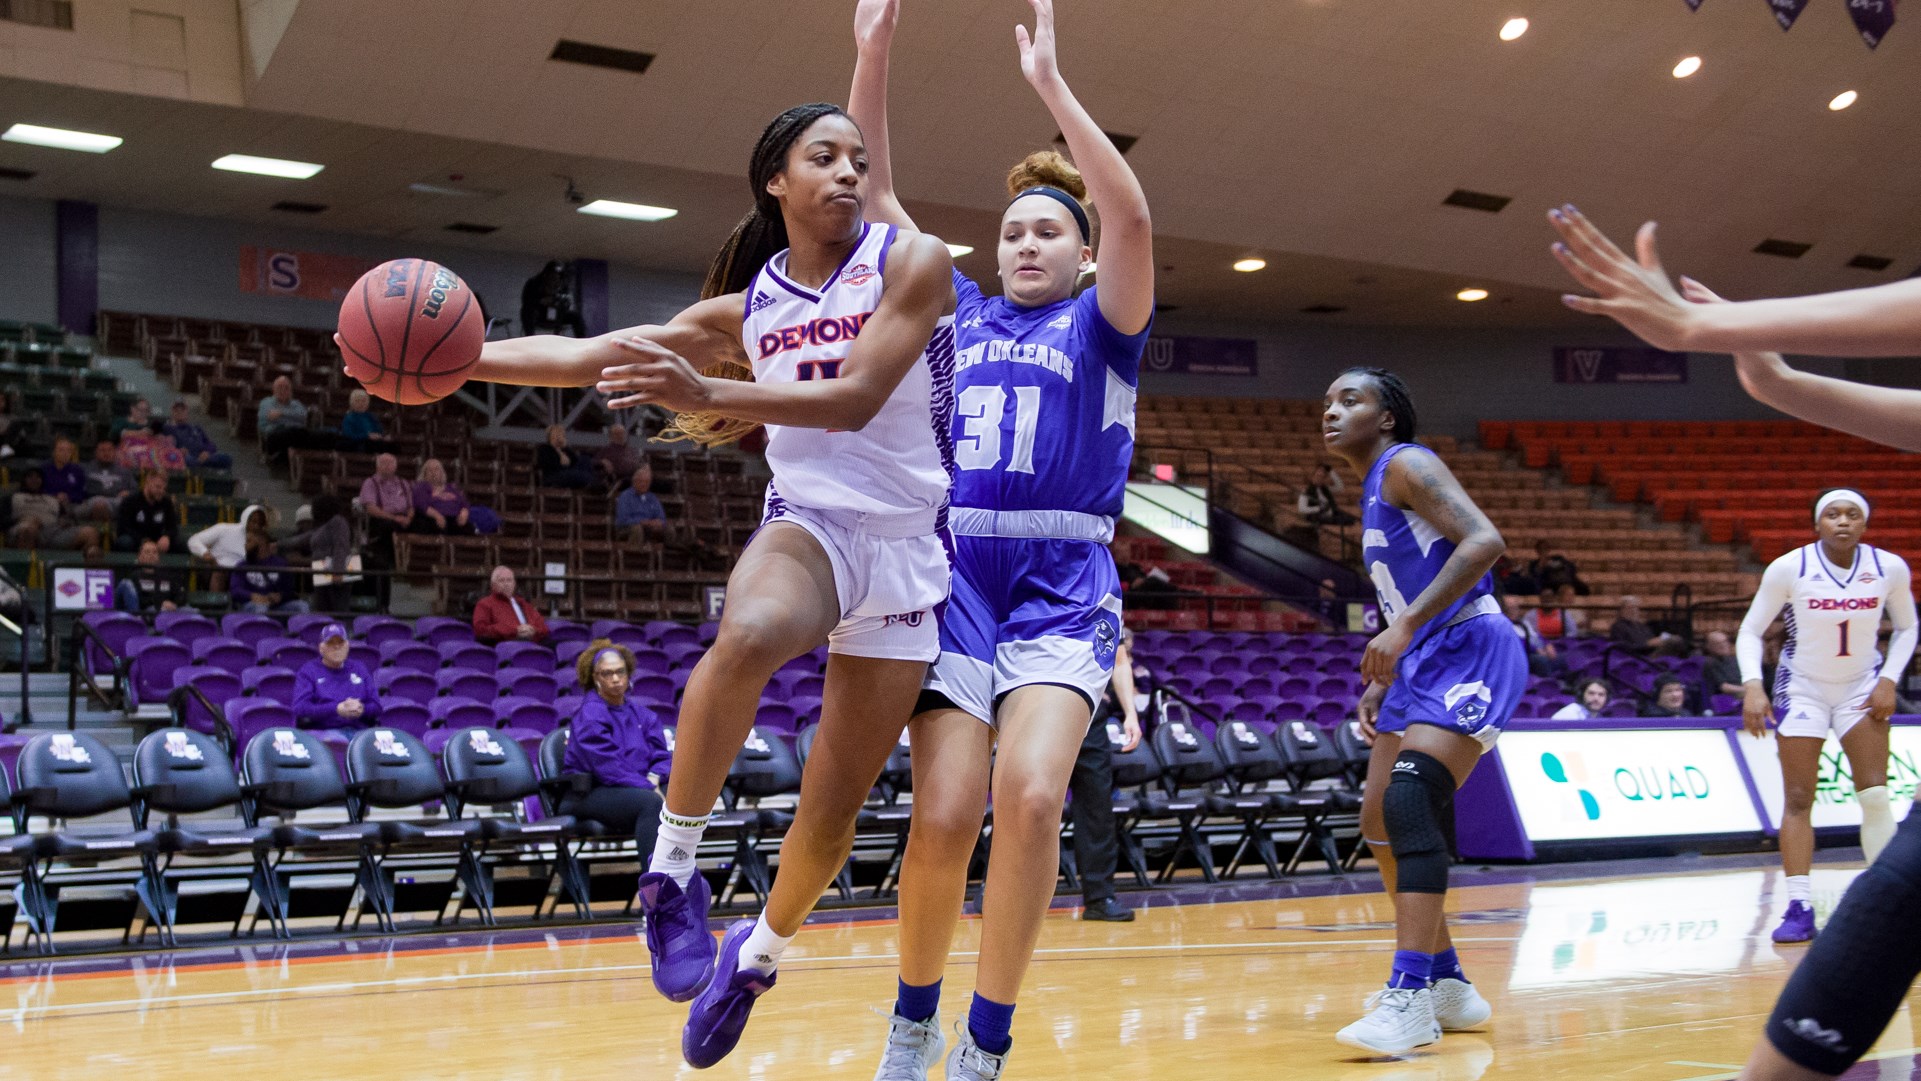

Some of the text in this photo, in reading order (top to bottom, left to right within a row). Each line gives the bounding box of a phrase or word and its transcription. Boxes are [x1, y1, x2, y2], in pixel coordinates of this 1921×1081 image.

[269, 254, 299, 290] S
[750, 298, 776, 313] adidas
[956, 340, 1074, 383] EW ORLEANS
[954, 385, 1041, 475] 31
[89, 577, 111, 602] F
[1808, 597, 1879, 611] DEMONS
[1835, 619, 1852, 657] 1
[1613, 766, 1709, 801] QUAD
